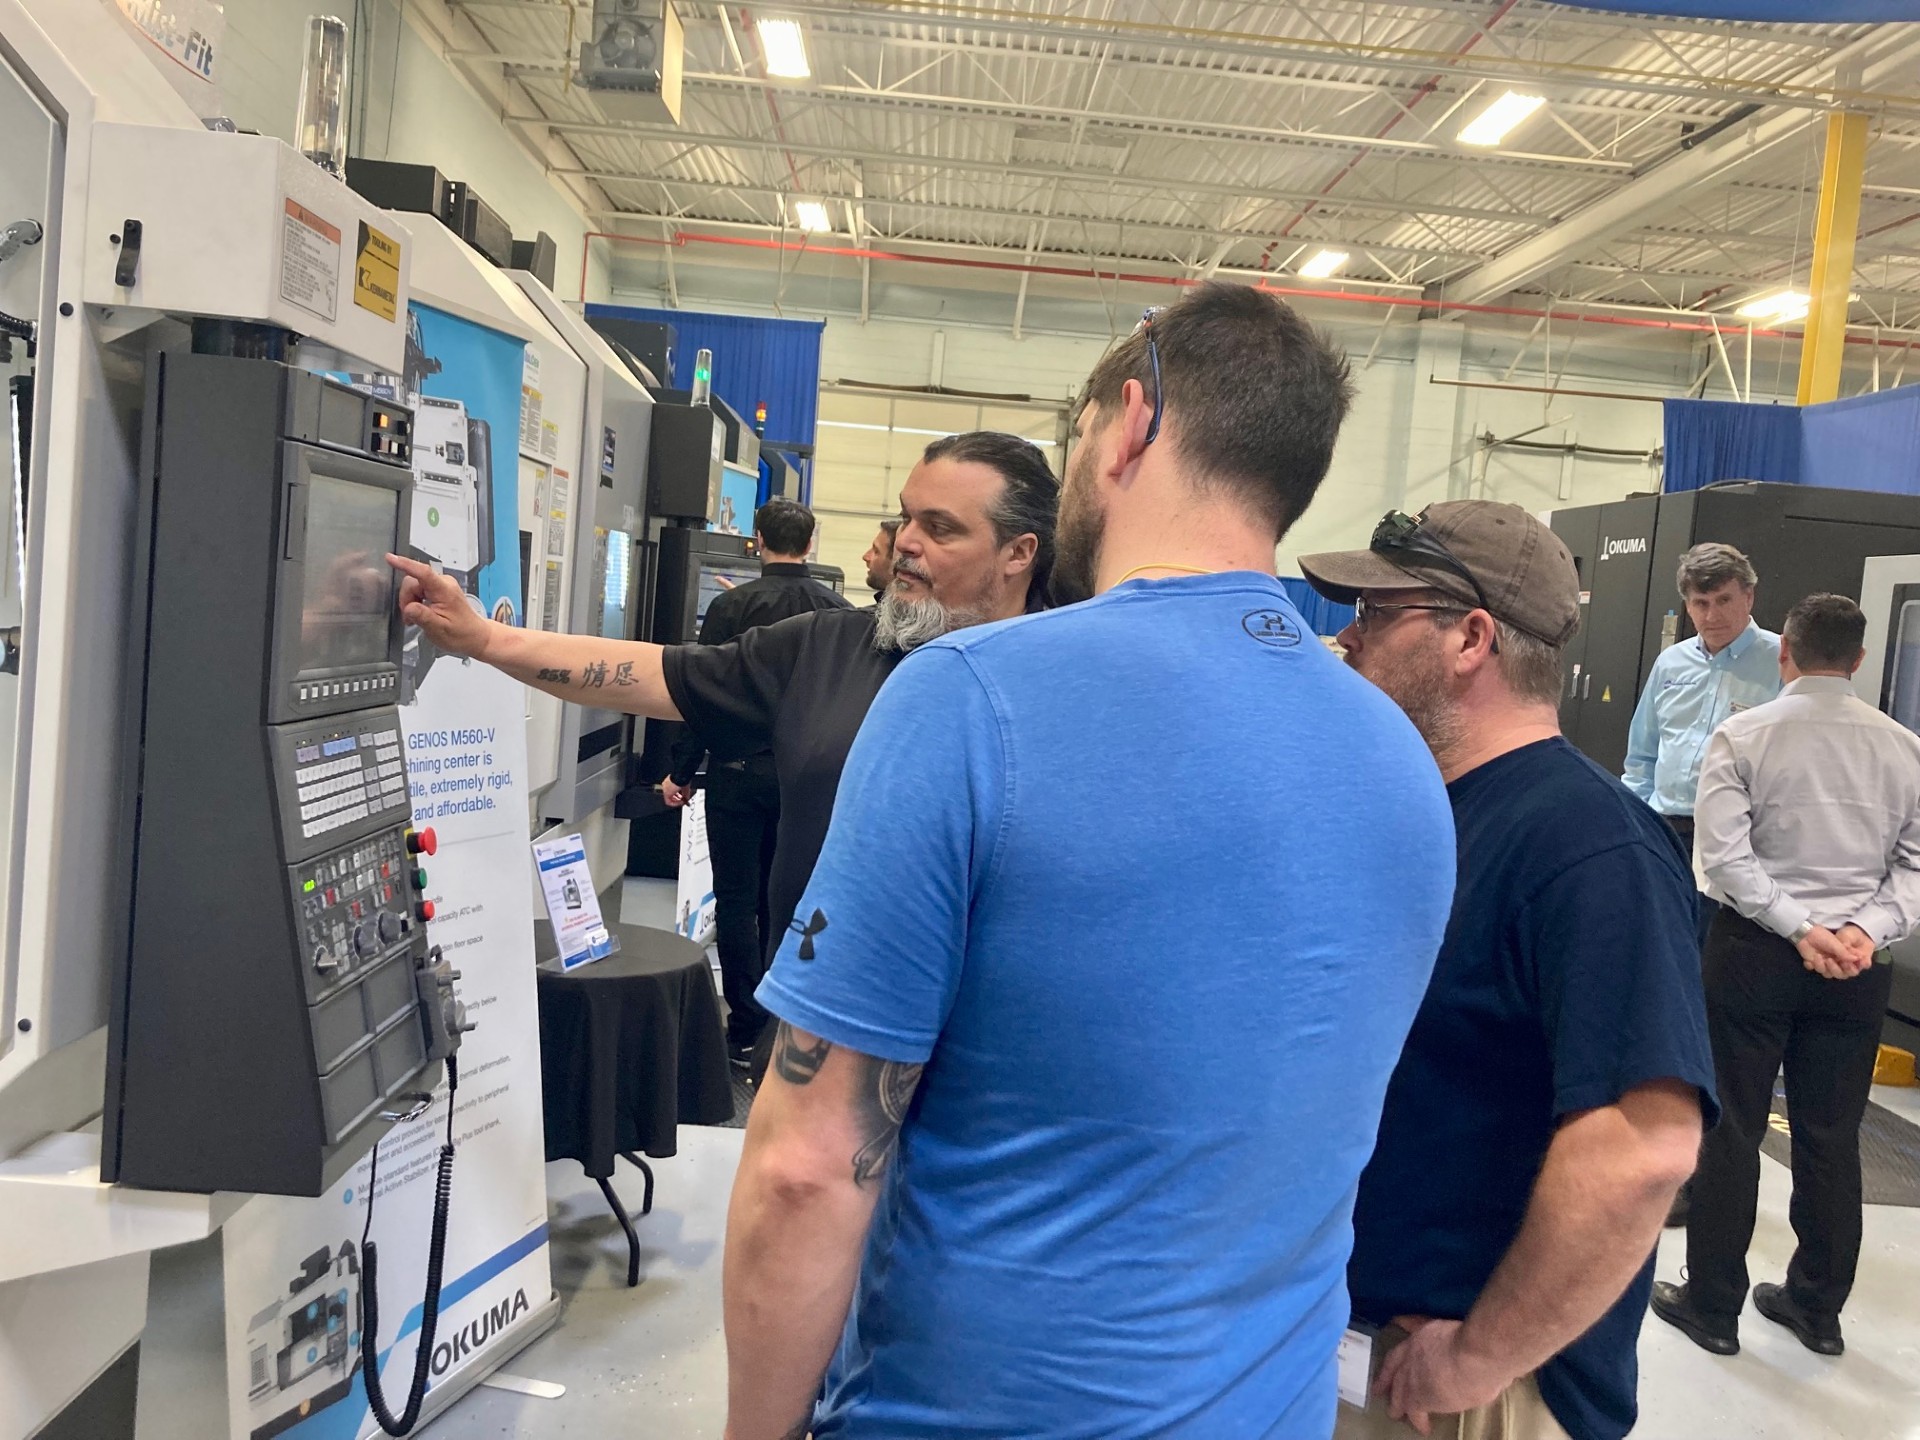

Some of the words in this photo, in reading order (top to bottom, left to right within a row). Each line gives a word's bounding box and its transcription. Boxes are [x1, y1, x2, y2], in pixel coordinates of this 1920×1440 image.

[1608, 537, 1647, 555] OKUMA
[408, 731, 448, 750] GENOS
[451, 727, 496, 746] M560-V
[444, 753, 480, 769] center
[483, 750, 493, 766] is
[430, 773, 485, 795] extremely
[487, 770, 513, 790] rigid,
[414, 803, 434, 821] and
[436, 795, 497, 817] affordable.
[431, 1287, 530, 1376] OKUMA
